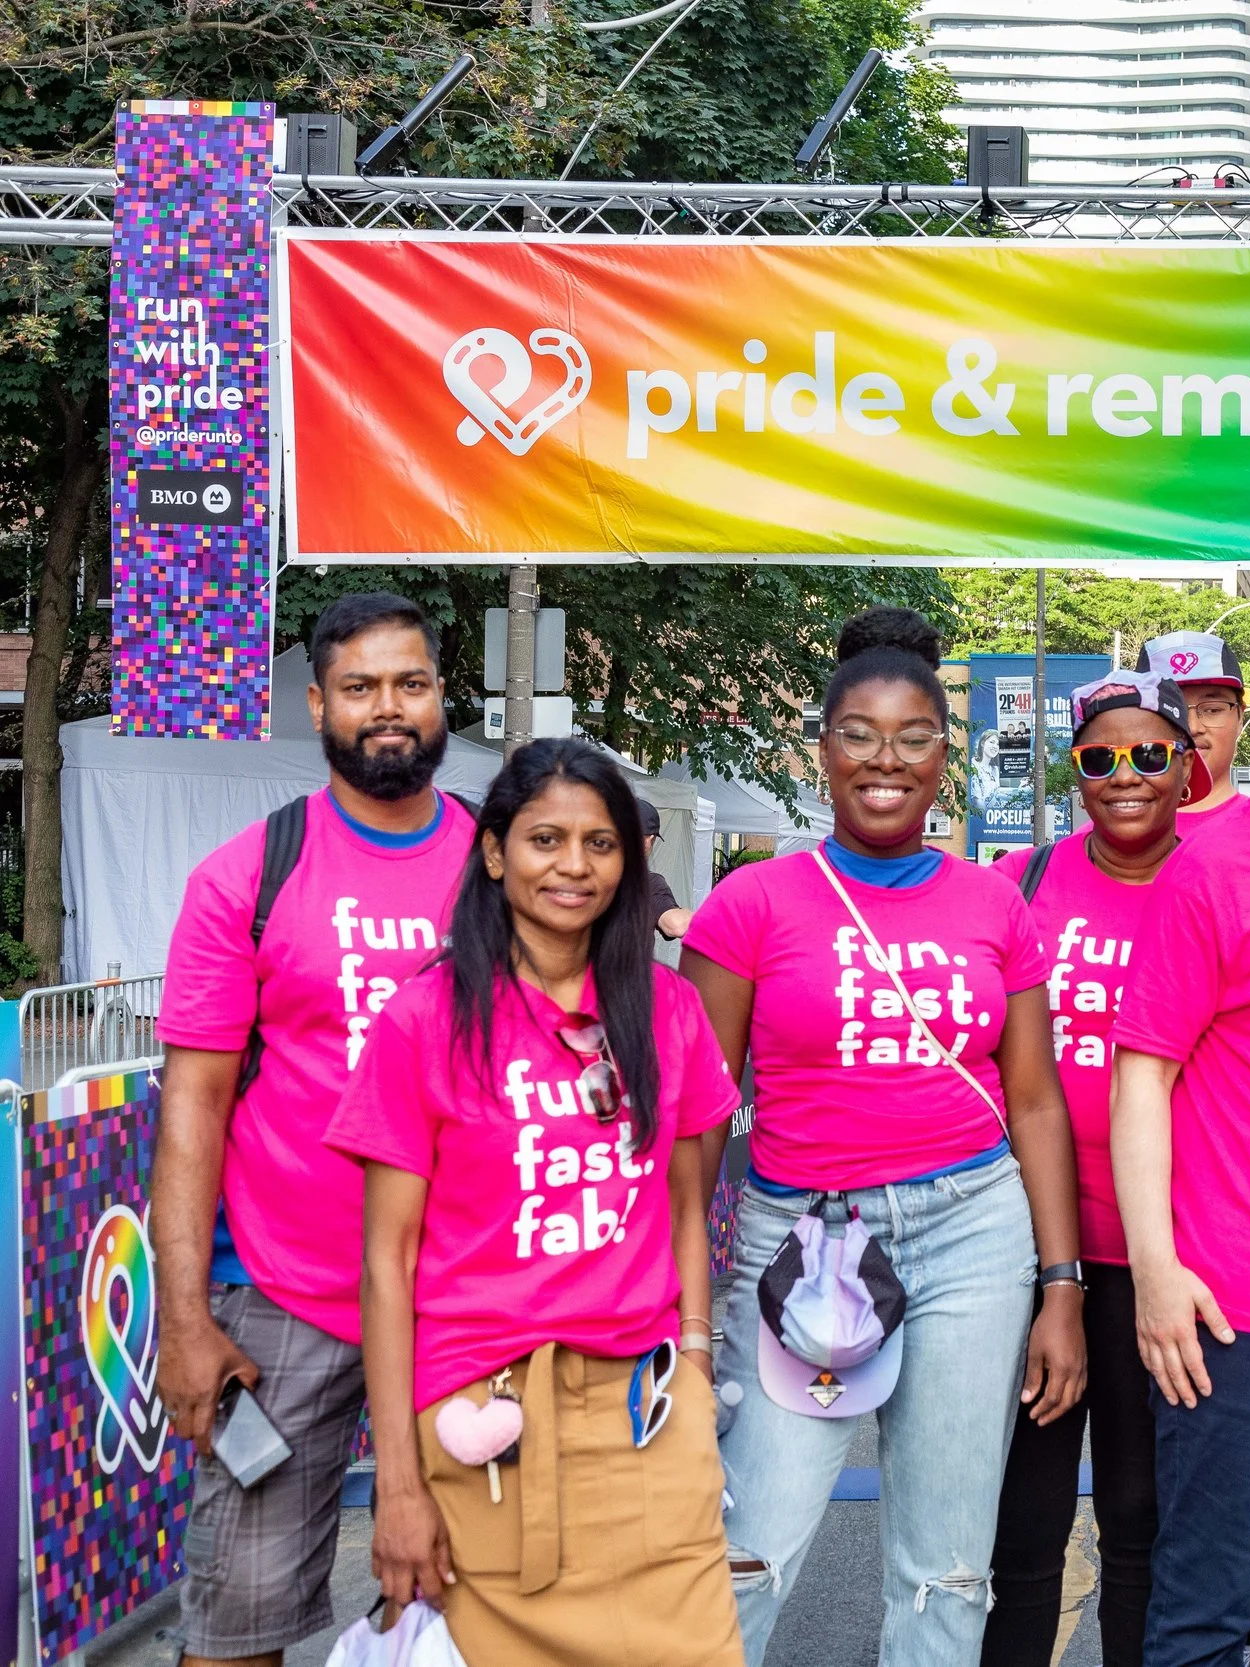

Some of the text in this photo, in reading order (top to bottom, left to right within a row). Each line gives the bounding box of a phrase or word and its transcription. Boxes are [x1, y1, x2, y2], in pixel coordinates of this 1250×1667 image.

[137, 297, 203, 322] run
[136, 321, 220, 366] with
[137, 364, 244, 420] pride
[626, 331, 906, 460] pride
[931, 337, 1021, 438] &
[136, 422, 243, 446] @priderunto
[150, 489, 198, 506] BMO
[999, 693, 1031, 710] 2P4H
[986, 809, 1022, 825] OPSEU
[833, 926, 968, 973] fun.
[835, 967, 990, 1027] fast.
[513, 1121, 655, 1191] fast.
[512, 1187, 639, 1258] fab!
